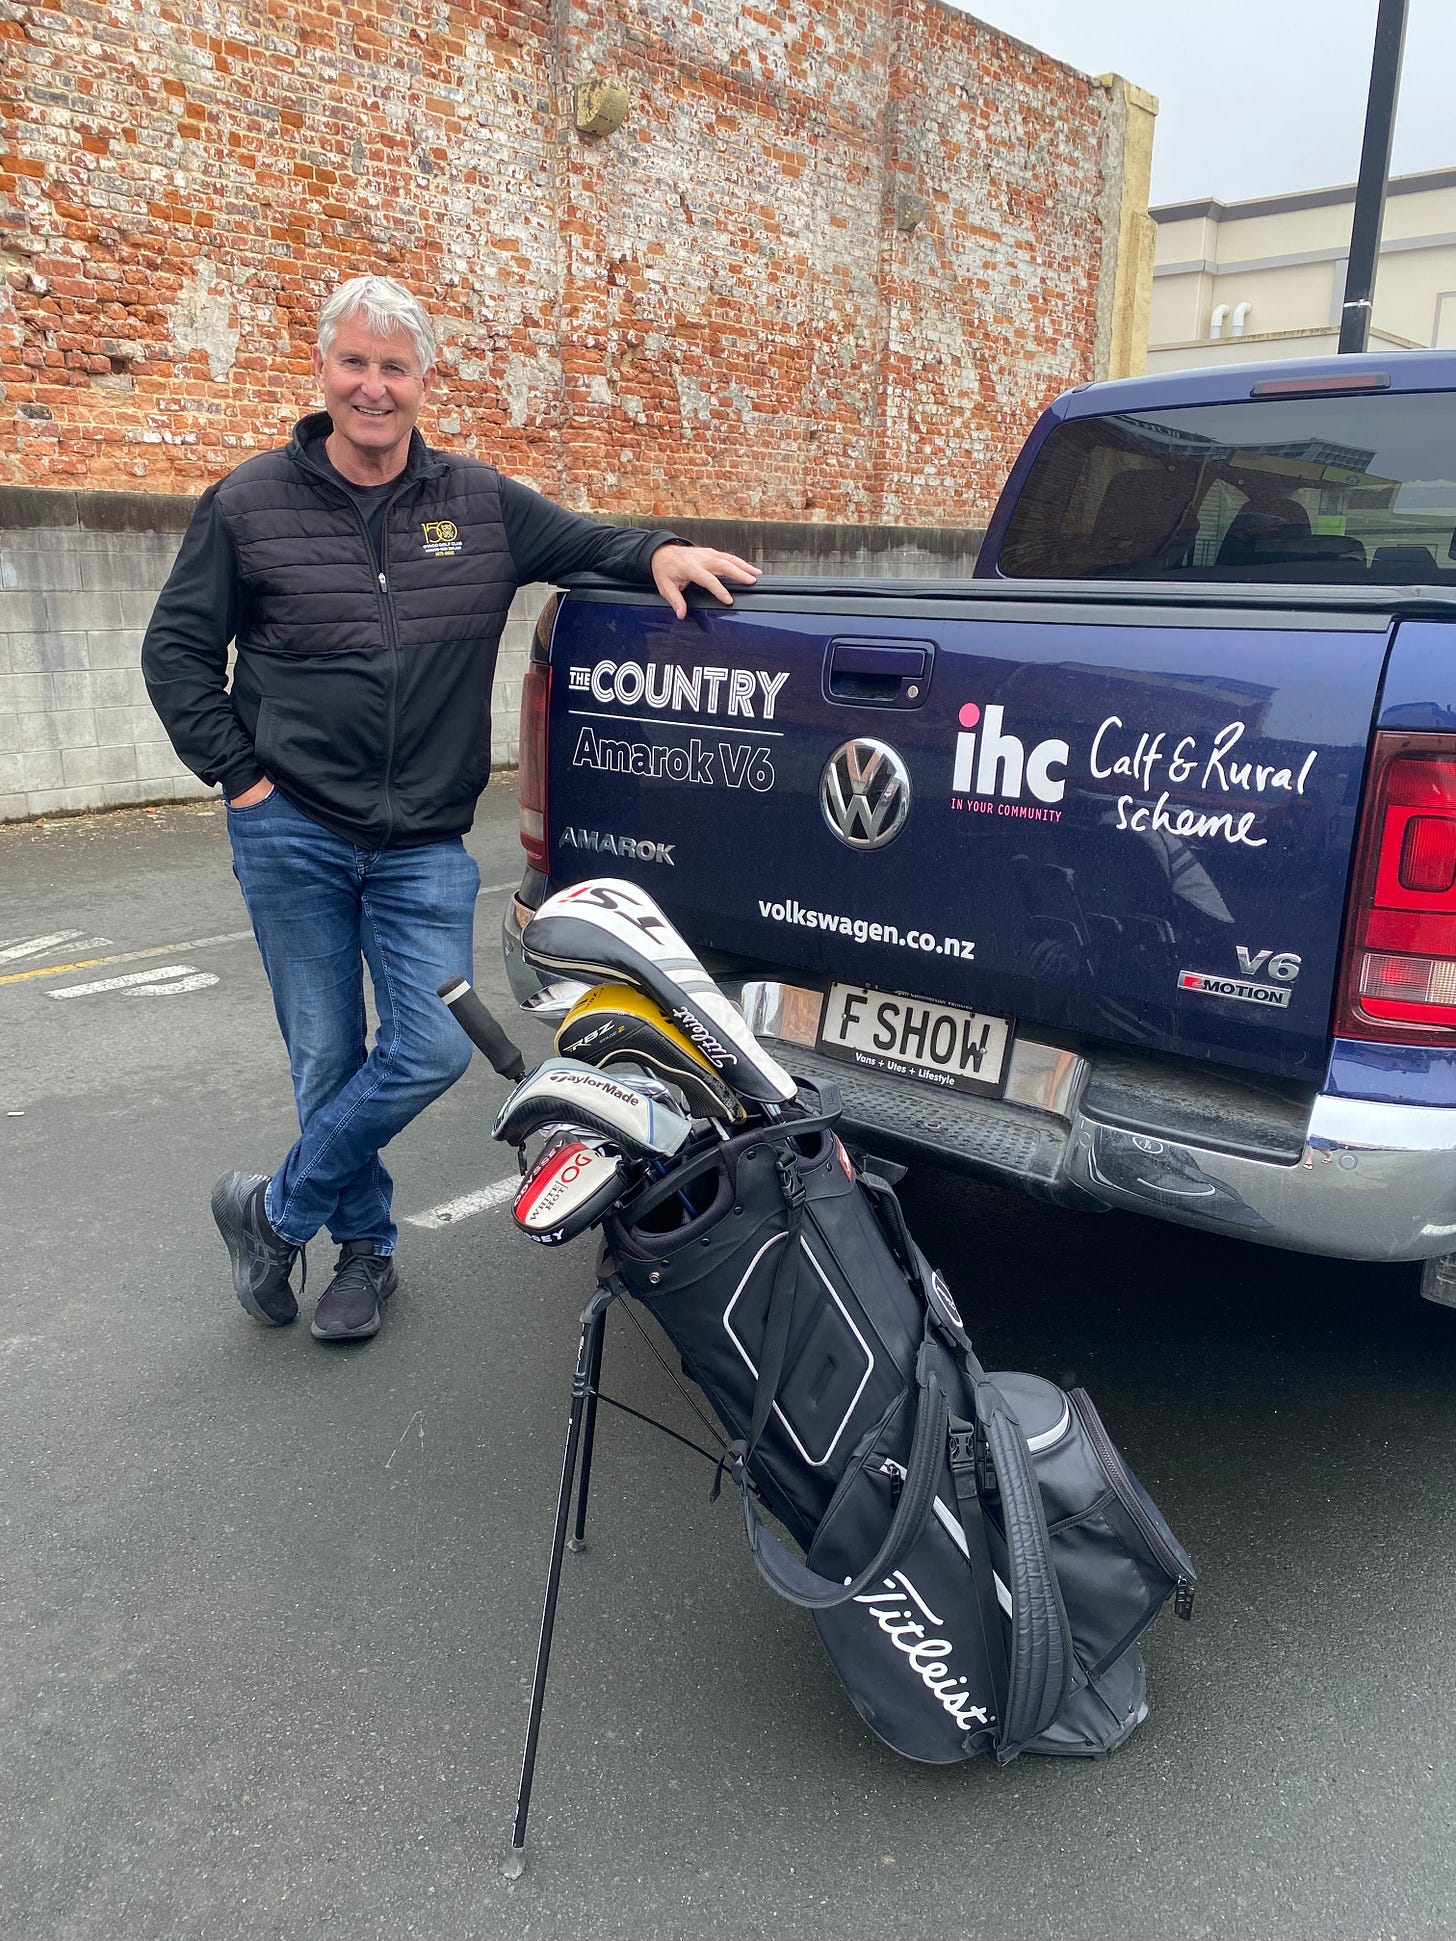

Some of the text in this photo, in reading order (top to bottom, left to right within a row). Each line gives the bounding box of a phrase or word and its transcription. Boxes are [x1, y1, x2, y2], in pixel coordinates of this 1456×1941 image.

[569, 660, 790, 719] THE COUNTRY
[572, 727, 775, 792] Amarok V6
[952, 702, 1070, 803] ihc
[1090, 716, 1317, 794] Calf & Rural
[951, 798, 1062, 822] IN YOUR COMMUNITY
[559, 826, 675, 866] AMAROK
[758, 900, 976, 960] volkswagen.co.nz
[1236, 946, 1302, 981] V6
[563, 1020, 615, 1052] RBZ
[672, 1006, 738, 1069] Titleist
[839, 993, 868, 1040] F
[872, 1002, 991, 1073] SHOW
[550, 1071, 639, 1106] TaylorMade
[855, 1052, 955, 1086] Vans + Utes + Lifestyle
[514, 1140, 563, 1206] ODYSSEY
[561, 1153, 592, 1183] OG
[530, 1184, 560, 1221] WHITE
[545, 1189, 565, 1211] HOT
[844, 1570, 992, 1730] Titleist
